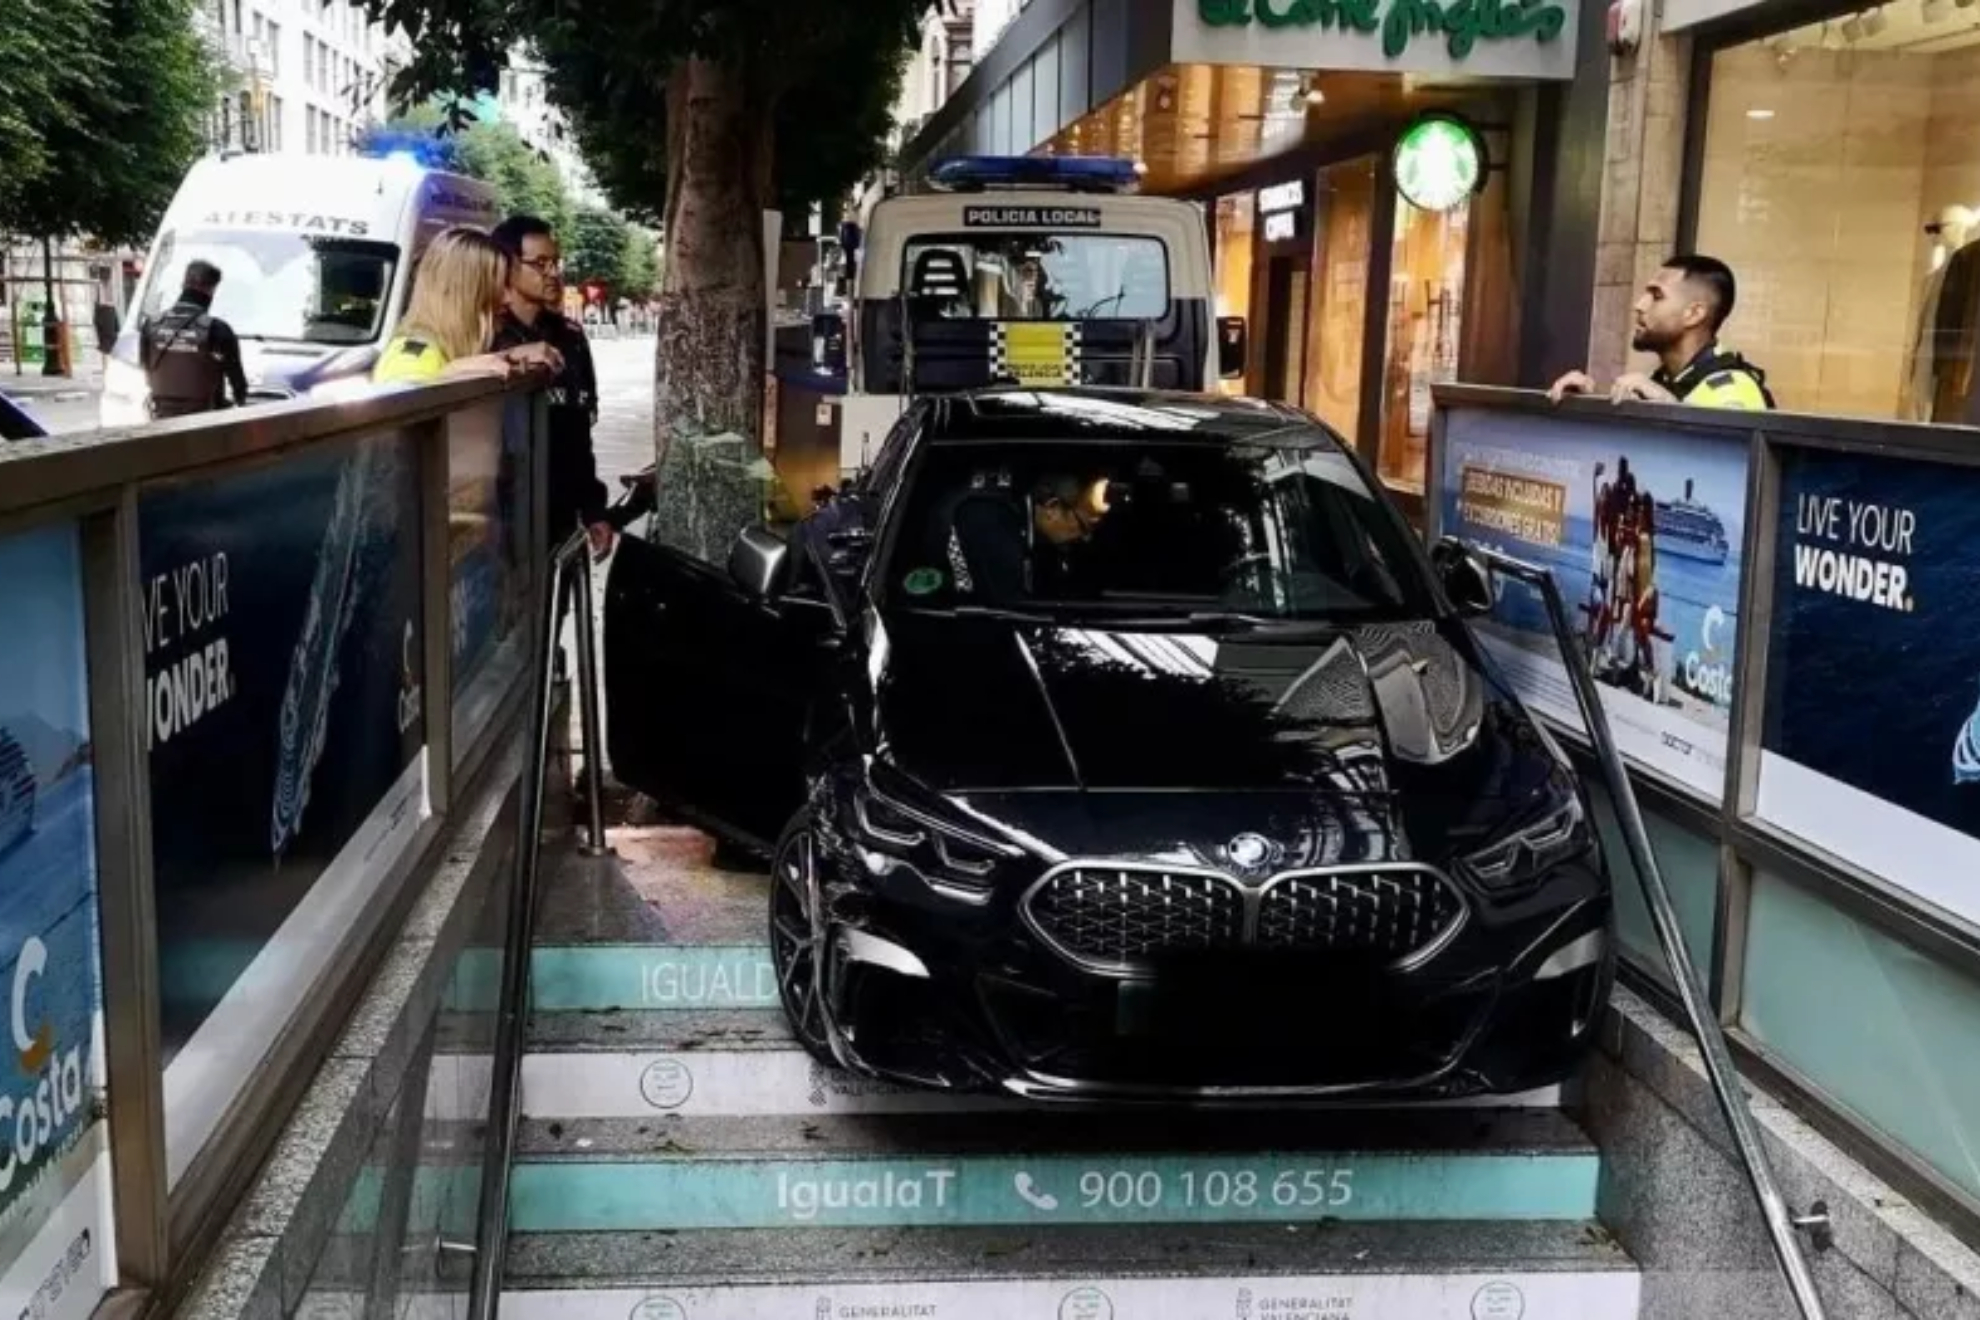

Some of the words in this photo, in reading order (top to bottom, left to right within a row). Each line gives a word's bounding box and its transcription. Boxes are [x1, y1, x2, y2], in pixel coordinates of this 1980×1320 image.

[968, 209, 1038, 224] POLICIA
[1041, 209, 1098, 224] LOCAL
[1796, 492, 1842, 540] LIVE
[1848, 499, 1916, 556] YOUR
[172, 551, 229, 637] YOUR
[1793, 543, 1914, 612] WONDER.
[776, 1170, 956, 1219] IgualaT
[1078, 1171, 1162, 1208] 900
[1182, 1170, 1258, 1208] 108
[1271, 1170, 1354, 1206] 655
[838, 1304, 938, 1318] GENERALITAT
[1259, 1298, 1353, 1311] GENERALITAT
